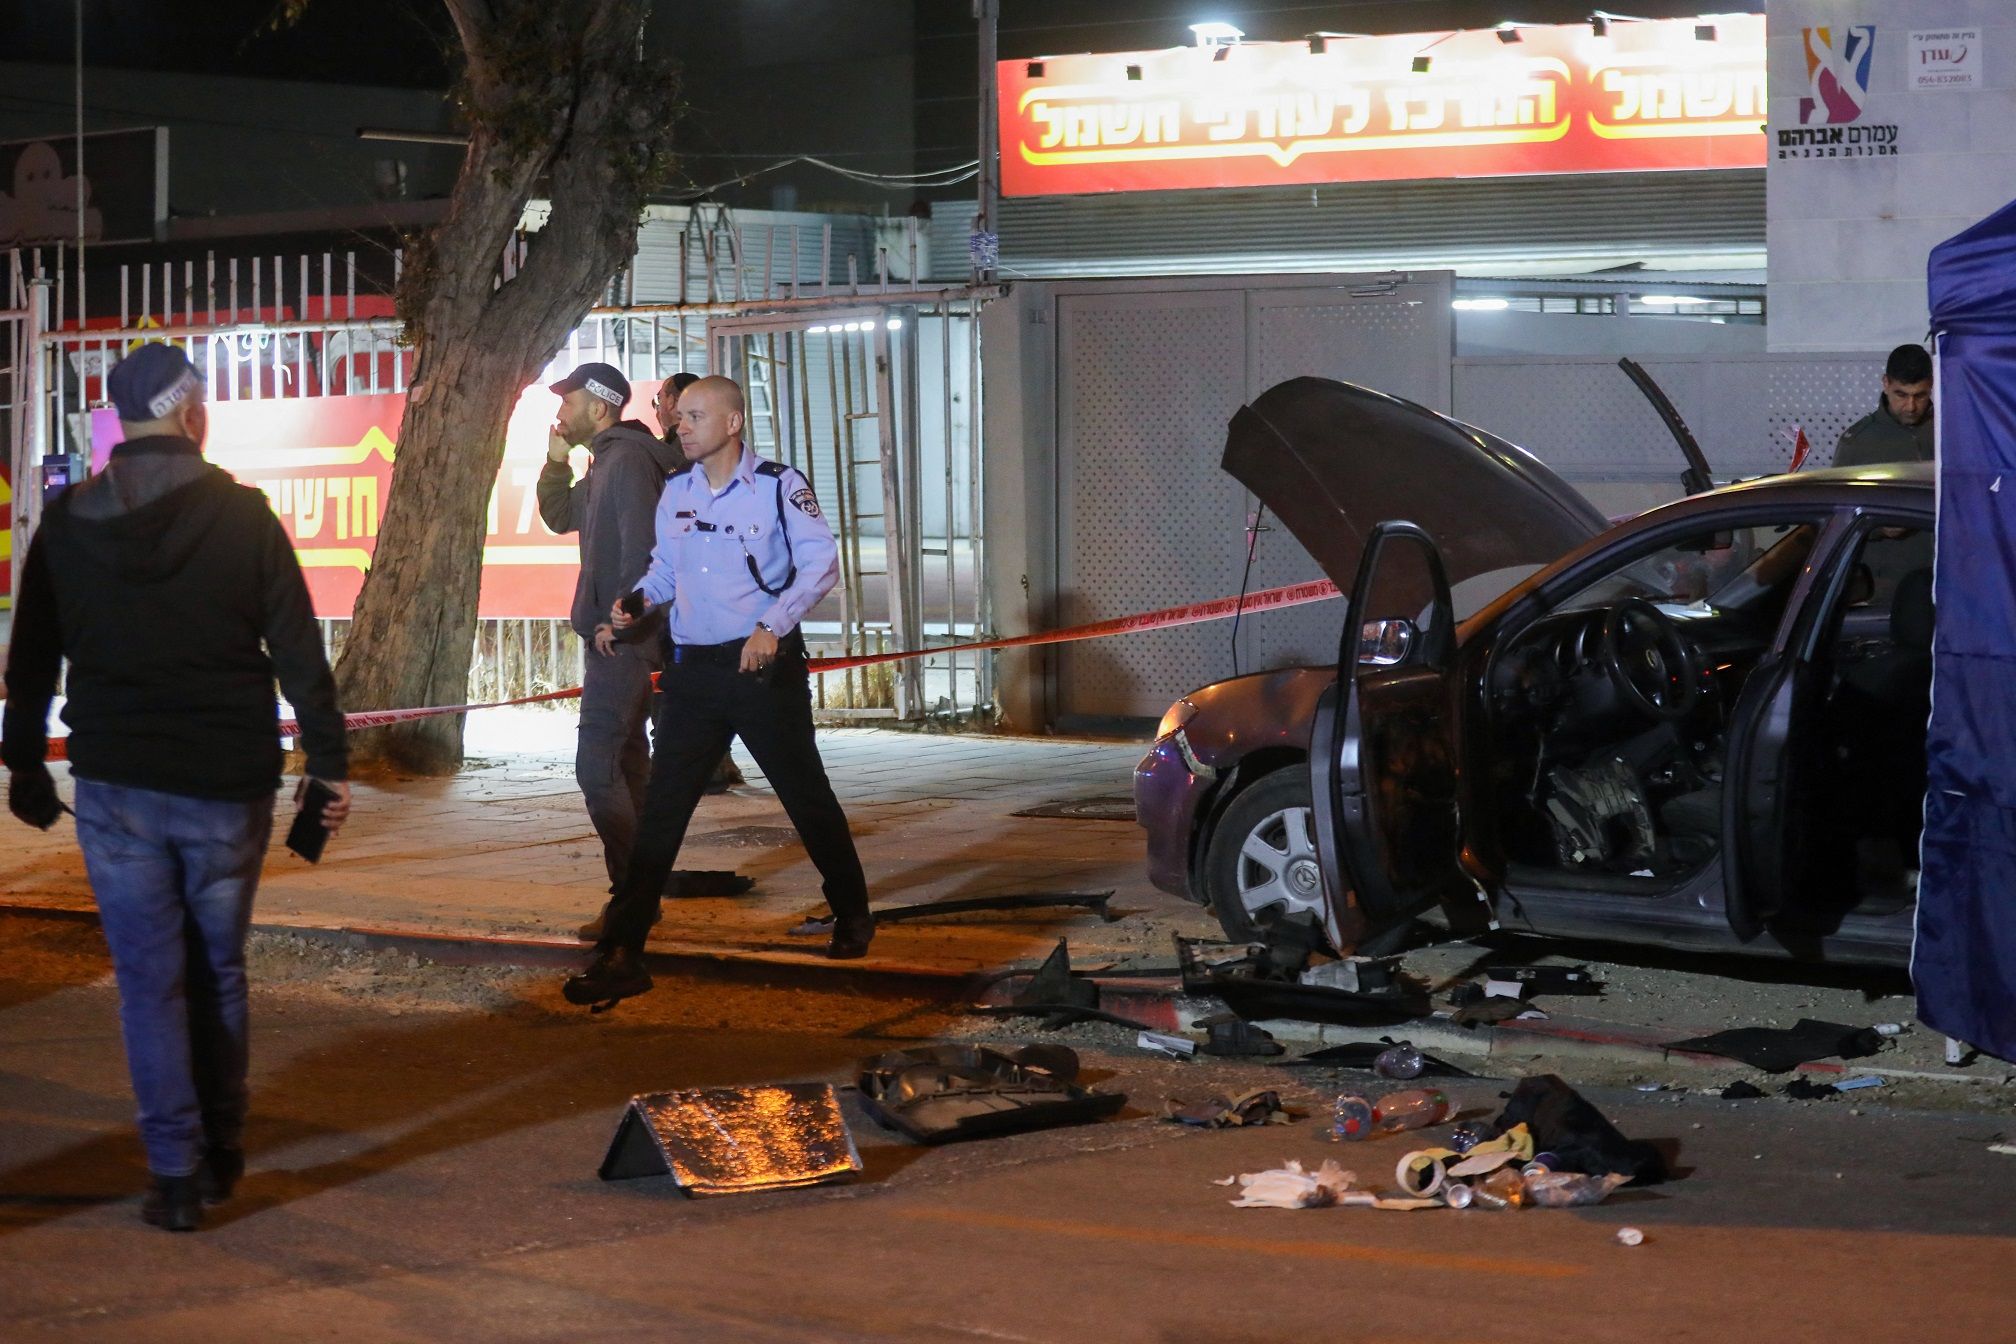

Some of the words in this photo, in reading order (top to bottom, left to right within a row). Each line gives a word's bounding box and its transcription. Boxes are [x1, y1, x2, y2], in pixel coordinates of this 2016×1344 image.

[1385, 78, 1557, 131] המרכז
[1603, 69, 1767, 120] חשמל
[1032, 100, 1180, 149] חשמל
[1192, 88, 1372, 142] לעודפי
[1778, 128, 1843, 147] אברהם
[1845, 145, 1899, 157] אמנות
[1848, 124, 1899, 144] עמרם
[588, 380, 622, 404] POLICE
